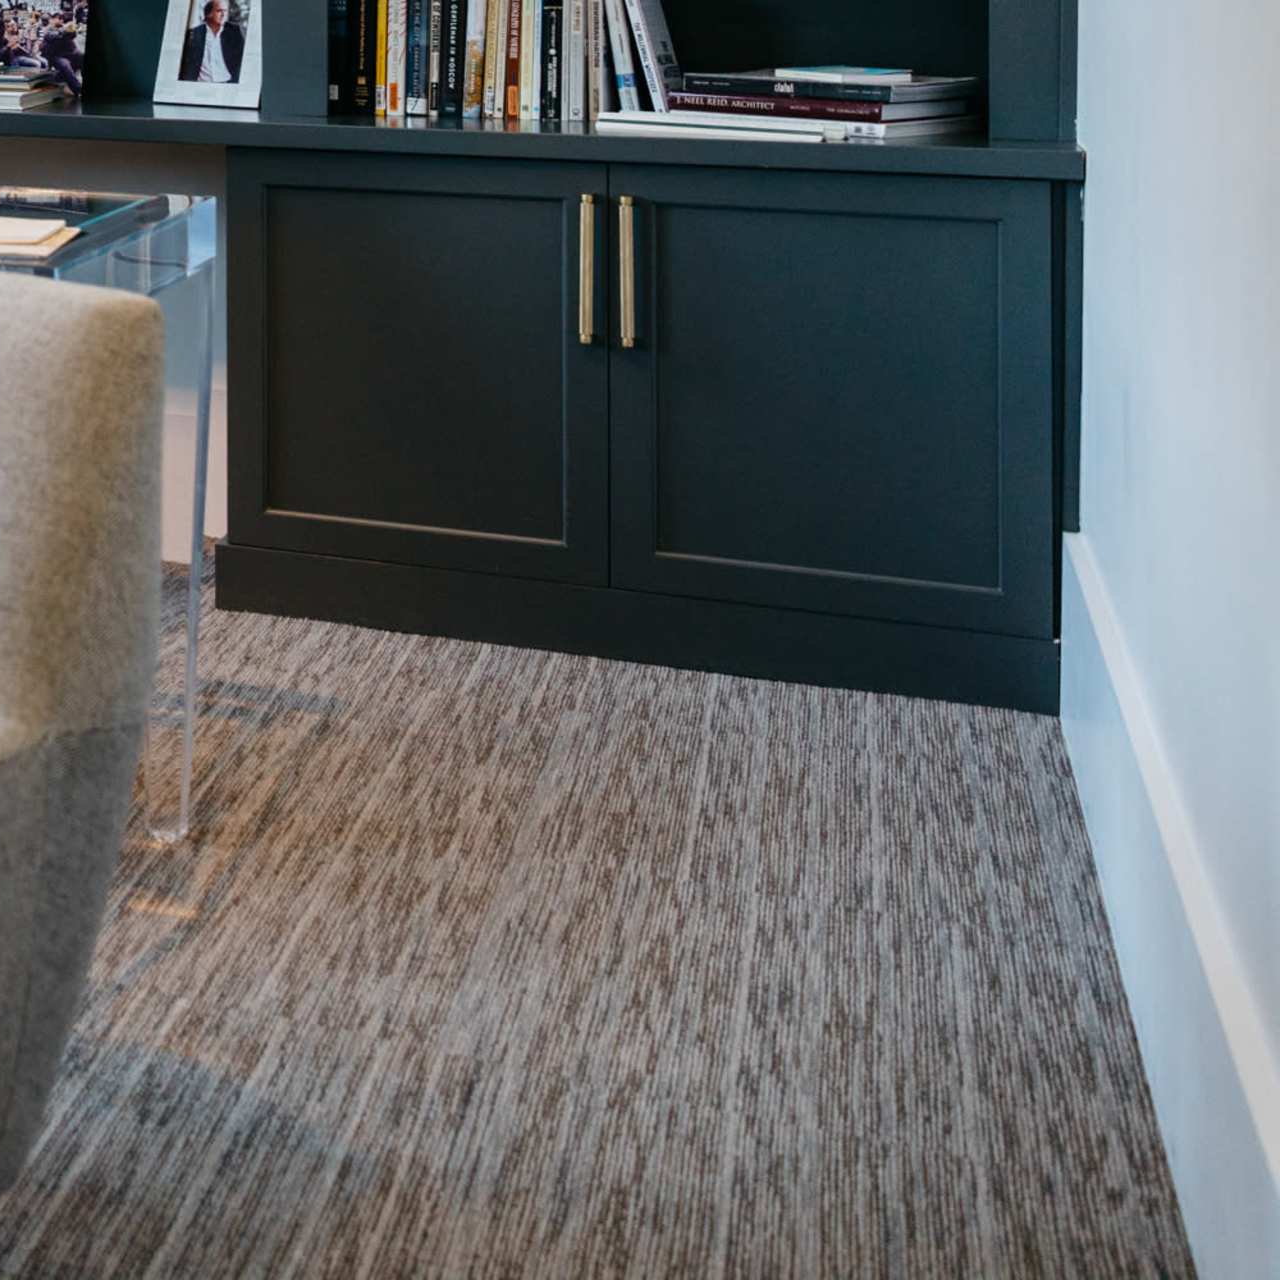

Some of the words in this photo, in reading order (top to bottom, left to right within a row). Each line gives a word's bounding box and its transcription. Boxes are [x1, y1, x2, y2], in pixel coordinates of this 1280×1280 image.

[450, 4, 458, 44] GENTLEMAN
[449, 47, 456, 55] IN
[448, 57, 456, 89] MOSCOW
[684, 96, 704, 105] NEEL
[731, 100, 775, 110] ARCHITECT
